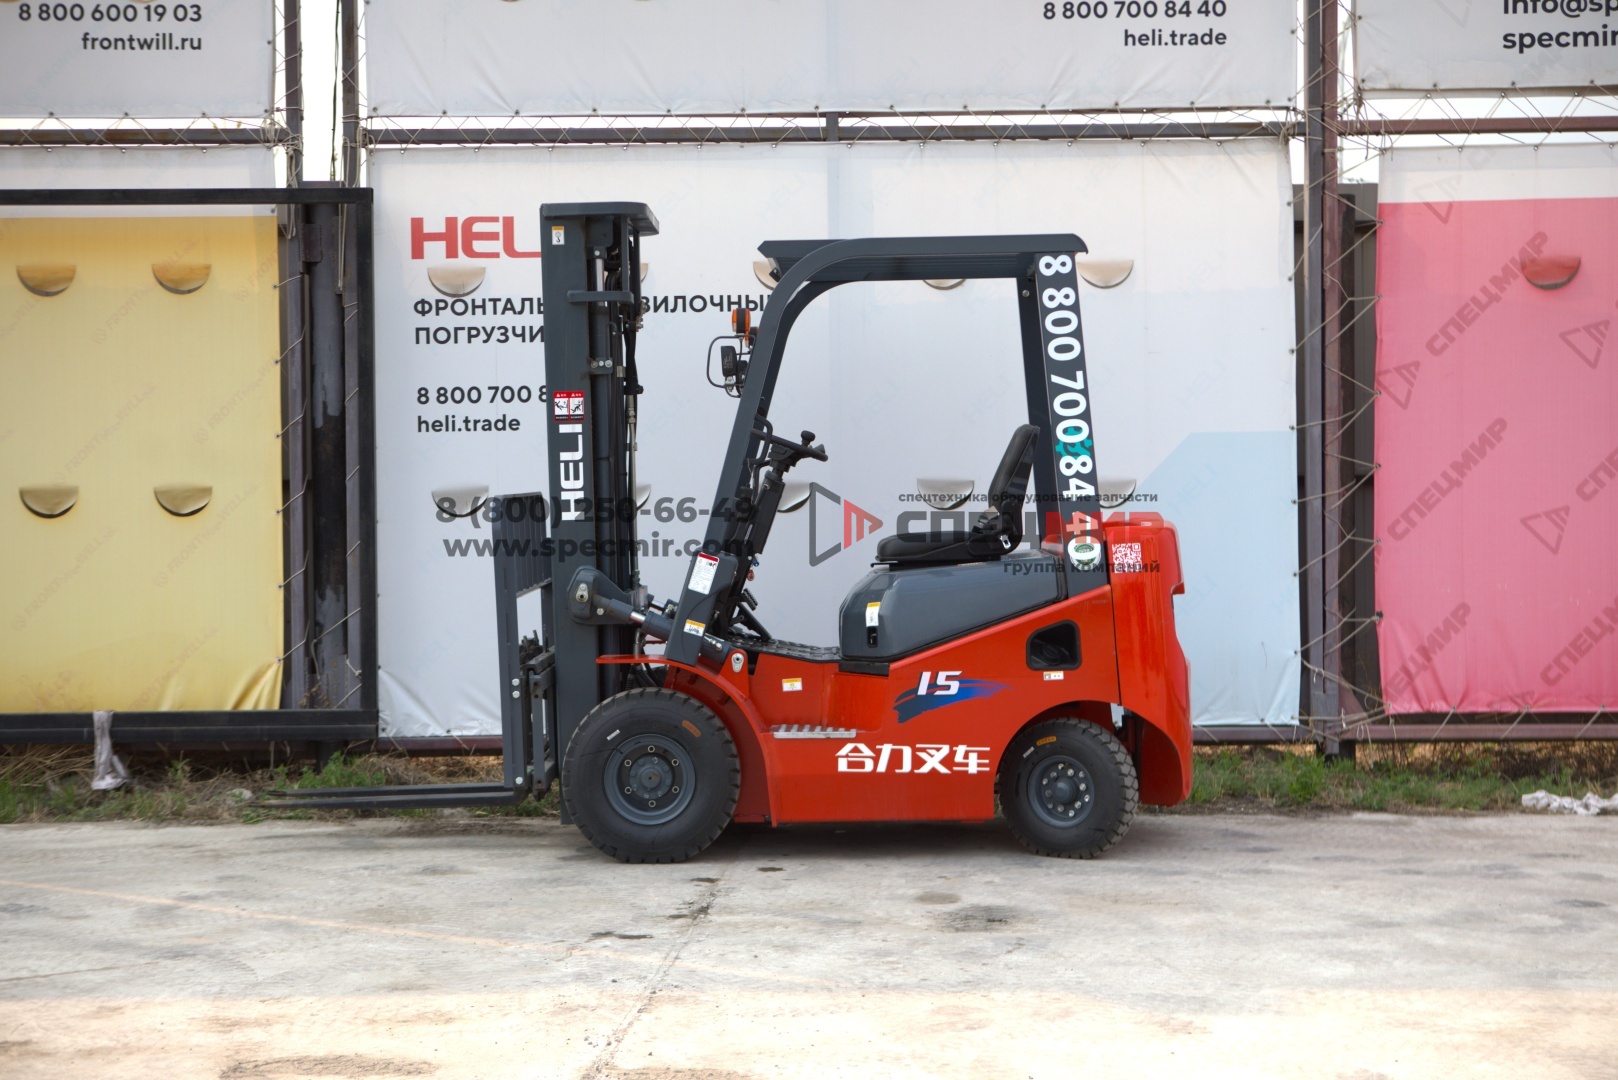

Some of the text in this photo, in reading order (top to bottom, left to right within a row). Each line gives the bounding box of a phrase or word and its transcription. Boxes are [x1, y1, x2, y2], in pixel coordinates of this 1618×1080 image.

[19, 3, 202, 22] 8 800 600 19 03
[1044, 0, 1226, 19] 8 800 700 84 40
[82, 32, 202, 50] frontwill.ru
[1124, 28, 1227, 46] heli.trade
[1039, 254, 1073, 277] 8
[641, 294, 771, 313] ИЛОЧНЫ
[1426, 231, 1549, 357] СПЕЦМИР
[1042, 286, 1082, 362] 800
[417, 387, 429, 405] 8
[436, 386, 481, 405] 800
[488, 385, 531, 404] 700
[1050, 371, 1090, 444] 700
[417, 414, 521, 433] heli.trade
[559, 423, 585, 521] HELI
[1059, 455, 1096, 500] 84
[1387, 417, 1508, 542] СПЕЦМИР
[1066, 511, 1101, 562] 40
[1386, 602, 1472, 702] ЕЦМИР
[917, 671, 962, 695] 15
[836, 742, 991, 775] 合力叉车
